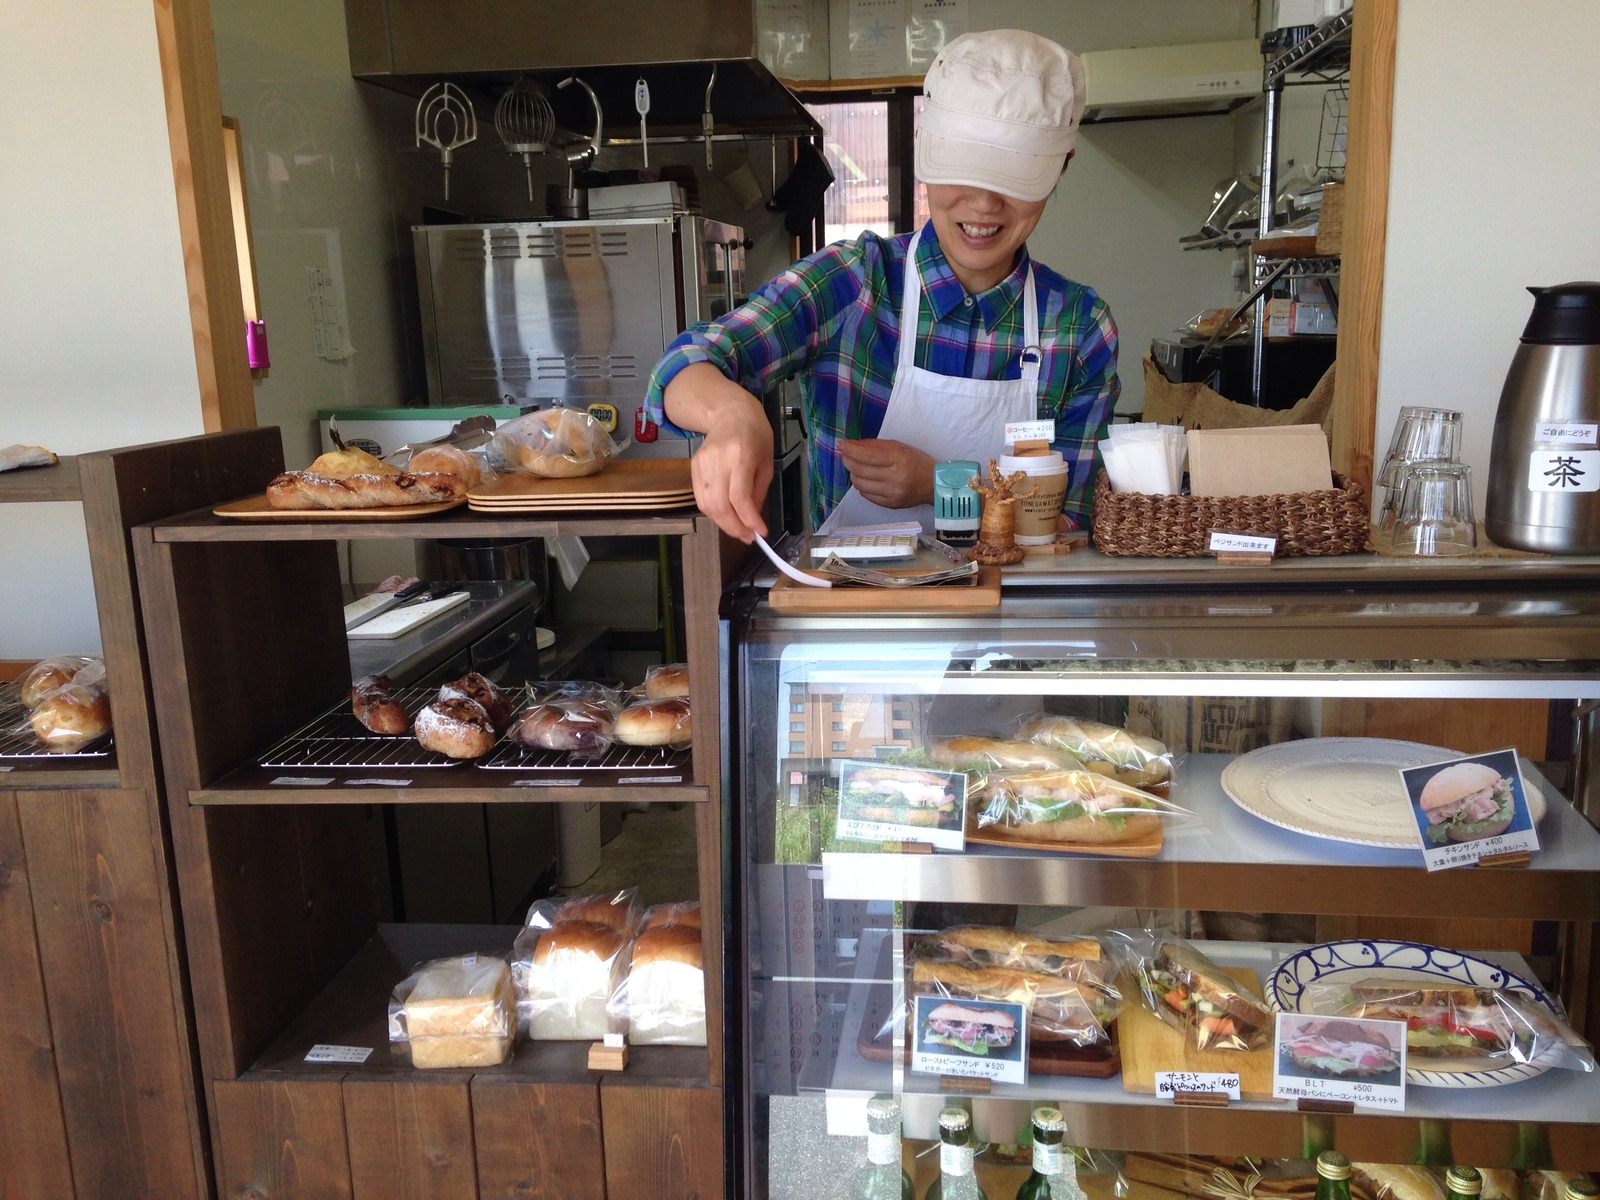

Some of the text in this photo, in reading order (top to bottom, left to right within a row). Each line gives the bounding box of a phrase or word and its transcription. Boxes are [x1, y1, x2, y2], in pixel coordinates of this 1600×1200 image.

[1543, 428, 1591, 437] ご自由にどうぞ
[1543, 456, 1585, 488] 茶
[1214, 539, 1270, 550] ベジサンド出来ます
[1444, 836, 1503, 855] チキンサンド ¥400
[921, 1056, 1005, 1071] ローストビーフサンド ¥520
[1166, 1072, 1199, 1083] サーモンと
[1353, 1084, 1373, 1093] ¥500
